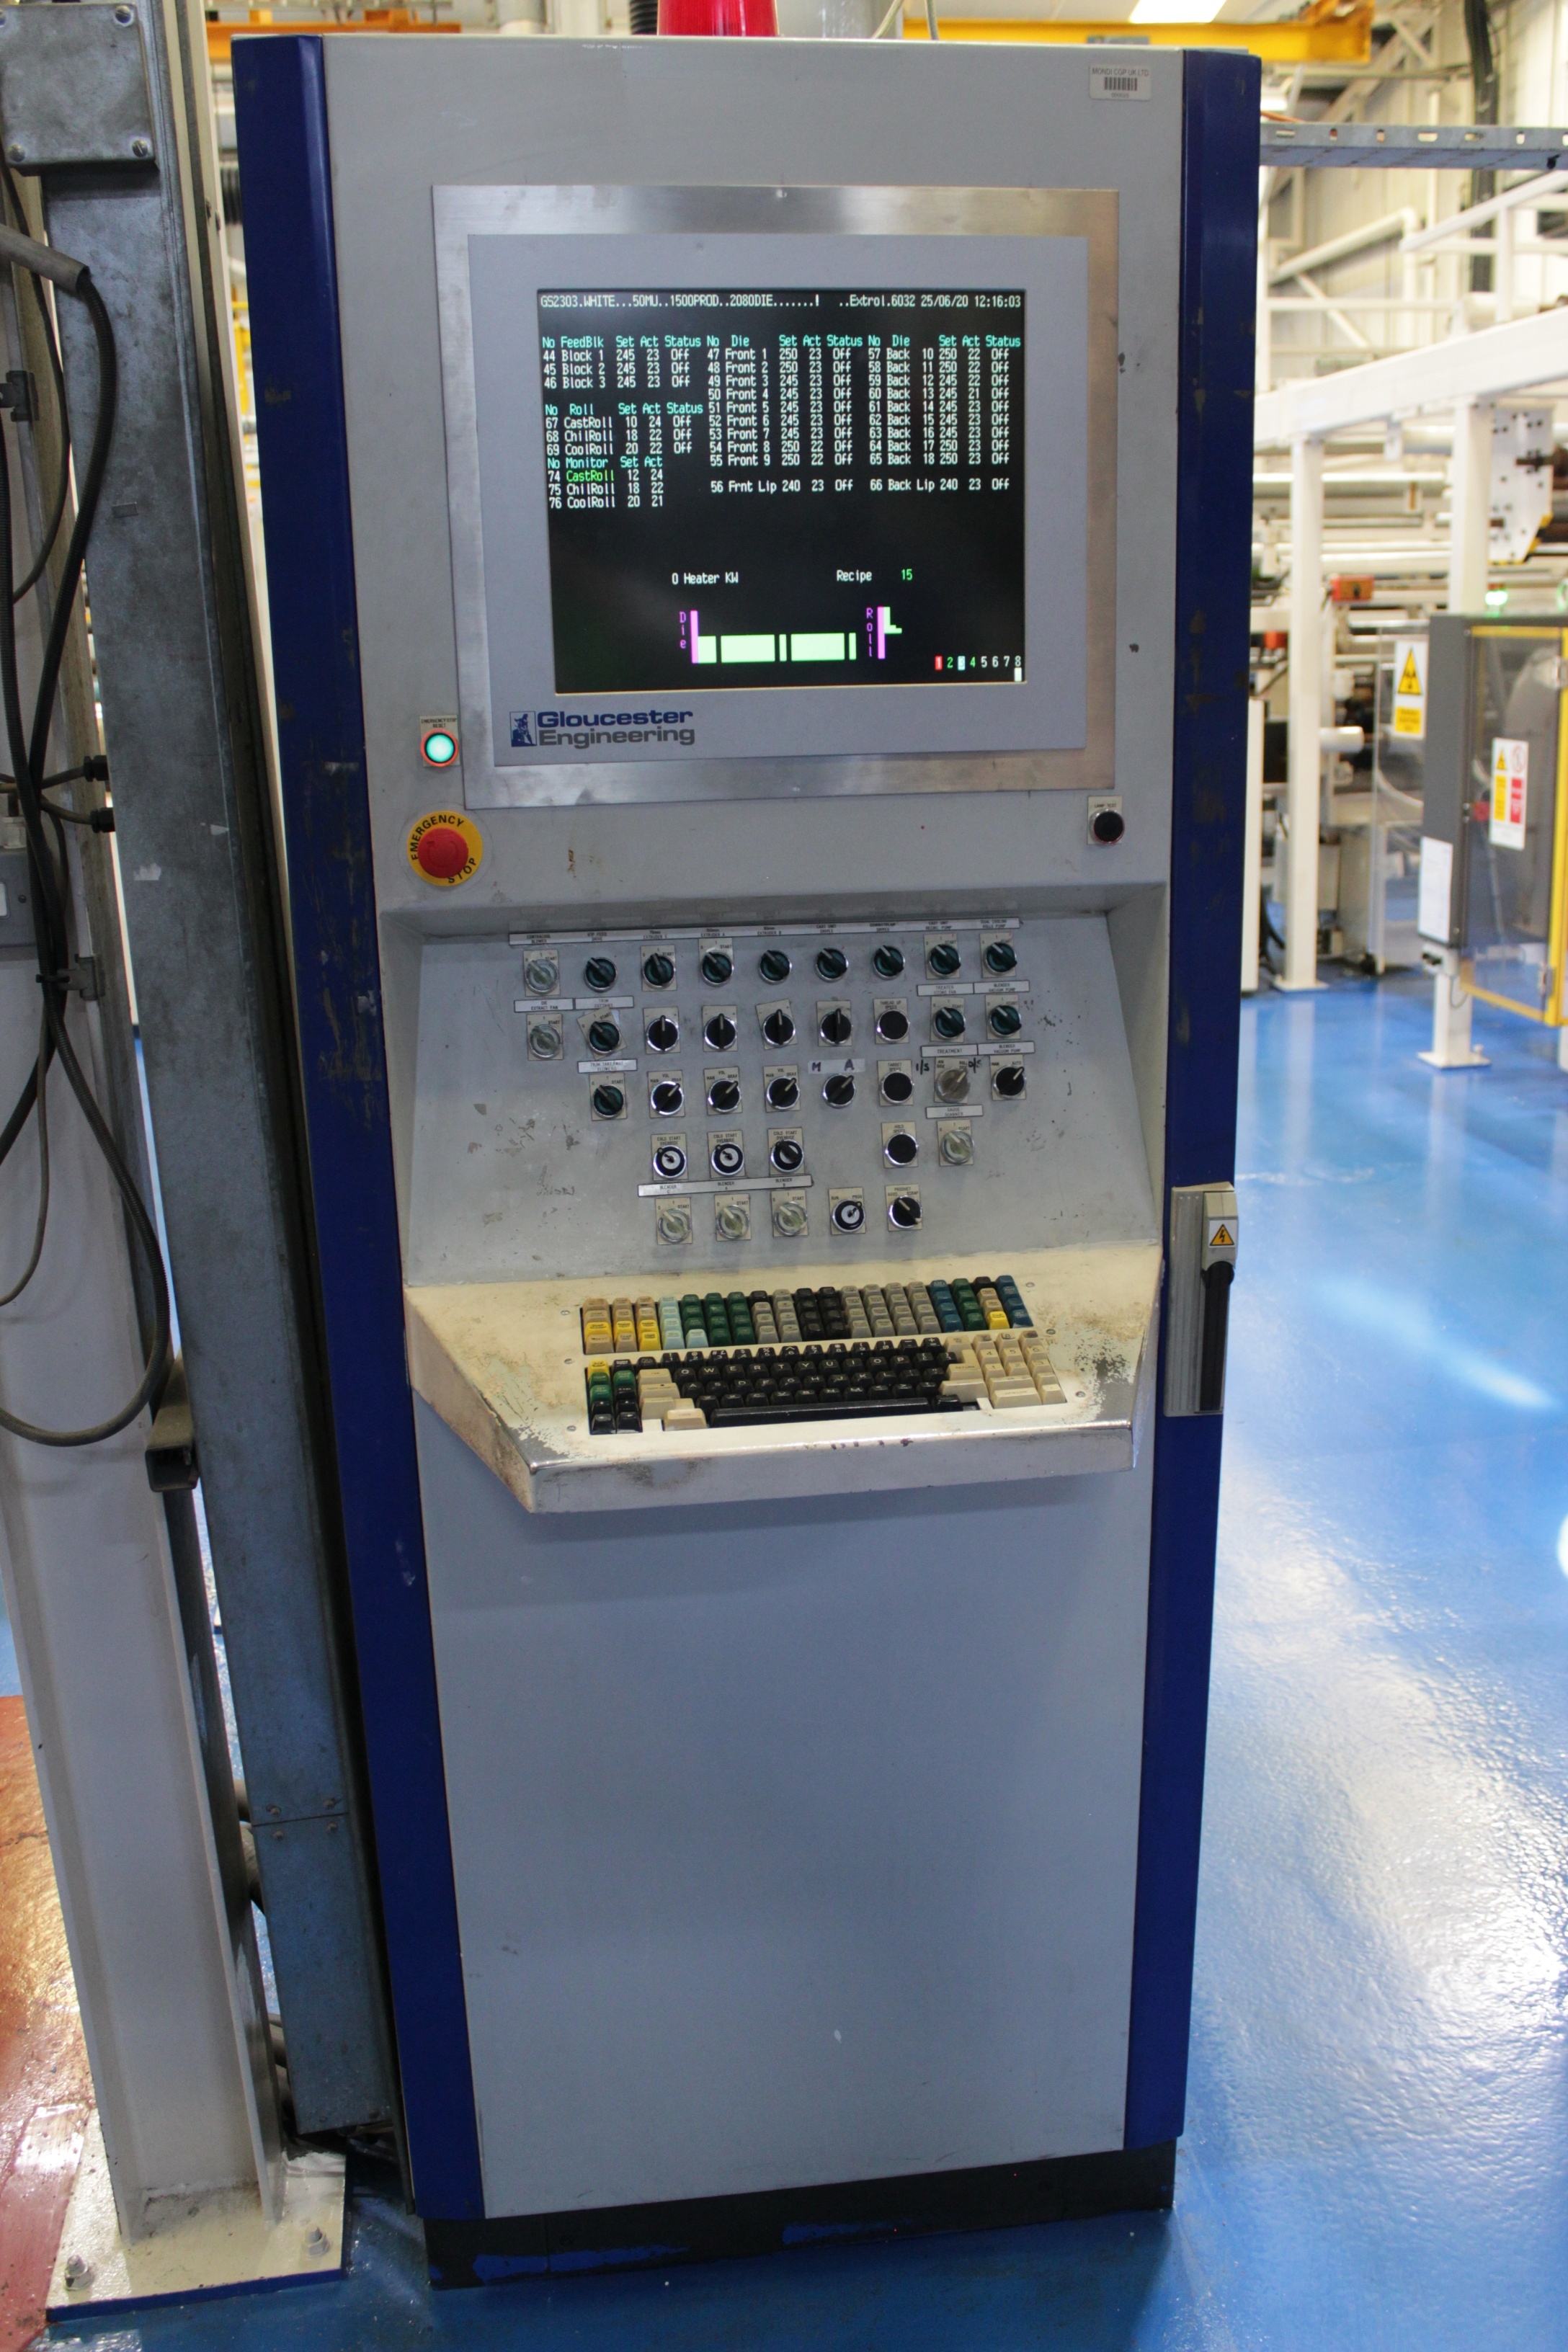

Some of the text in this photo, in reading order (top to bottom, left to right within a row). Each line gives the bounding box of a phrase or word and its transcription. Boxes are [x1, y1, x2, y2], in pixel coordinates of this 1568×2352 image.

[921, 295, 969, 307] 25/06/20
[975, 295, 1021, 308] 12:16:03
[542, 334, 702, 349] No FeedBlk Set Act Status
[706, 334, 863, 347] No Die Set Act Status
[868, 334, 1021, 347] No Die Set Act Status
[543, 349, 556, 362] 44
[561, 349, 592, 362] Block
[616, 348, 636, 362] 245
[646, 348, 659, 361] 23
[671, 348, 690, 361] Off
[707, 347, 720, 360] 47
[725, 347, 756, 360] Front
[779, 347, 798, 360] 250
[808, 347, 822, 360] 23
[832, 347, 851, 360] Off
[868, 347, 1009, 361] 57 Back 10 250 22 Off
[544, 362, 556, 375] 45
[562, 362, 593, 375] Block
[617, 362, 636, 375] 245
[647, 361, 660, 375] 23
[671, 361, 690, 375] Off
[545, 376, 557, 389] 46
[562, 376, 594, 389] Block
[617, 375, 636, 388] 245
[647, 375, 661, 388] 23
[672, 375, 690, 388] Off
[545, 401, 703, 416] No Roll Set Act Status
[545, 414, 692, 429] 67 CastRoll 10 24 Off
[546, 428, 692, 442] 68 ChilRoll 18 22 Off
[547, 441, 692, 456] 69 CoolRoll 20 22 Off
[548, 455, 663, 469] No Monitor Set Act
[548, 468, 664, 482] 74 CastRoll 12 24
[548, 481, 664, 496] 75 ChilRoll 18 22
[549, 494, 663, 509] 76 CoolRoll 20 21
[684, 572, 720, 584] Heater
[725, 571, 739, 584] KW
[836, 569, 913, 583] Recipe 15
[536, 709, 694, 728] Gloucester
[538, 727, 695, 749] Engineering
[409, 814, 464, 860] EMERGENCY
[447, 857, 476, 883] STOP
[811, 1059, 855, 1072] M A
